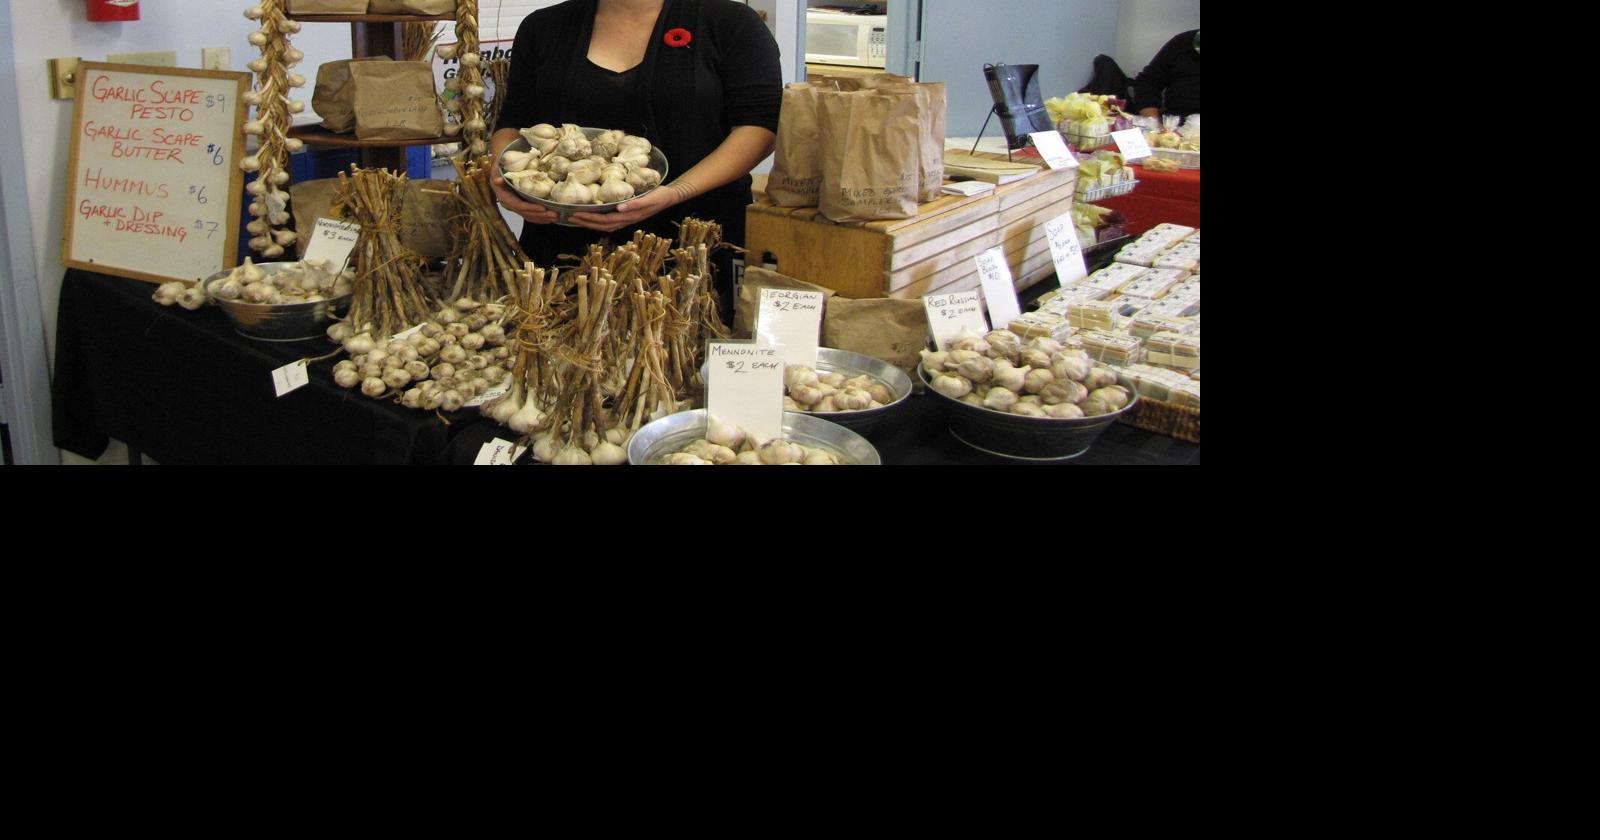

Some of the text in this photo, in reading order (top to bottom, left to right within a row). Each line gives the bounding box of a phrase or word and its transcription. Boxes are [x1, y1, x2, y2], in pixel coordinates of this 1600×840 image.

[92, 75, 226, 113] GARLIC SCAPE $9
[130, 104, 194, 122] PESTO
[84, 120, 224, 166] GARLIC SCAPE $6
[111, 141, 185, 164] BUTTER
[84, 167, 208, 204] HUMMUS $6
[79, 199, 219, 239] GARLIC DIP $7
[115, 220, 187, 242] DRESSING
[773, 301, 816, 312] $2 EACH
[940, 308, 956, 319] $2
[711, 344, 776, 356] MENNONITE
[725, 360, 778, 373] $2 EACH
